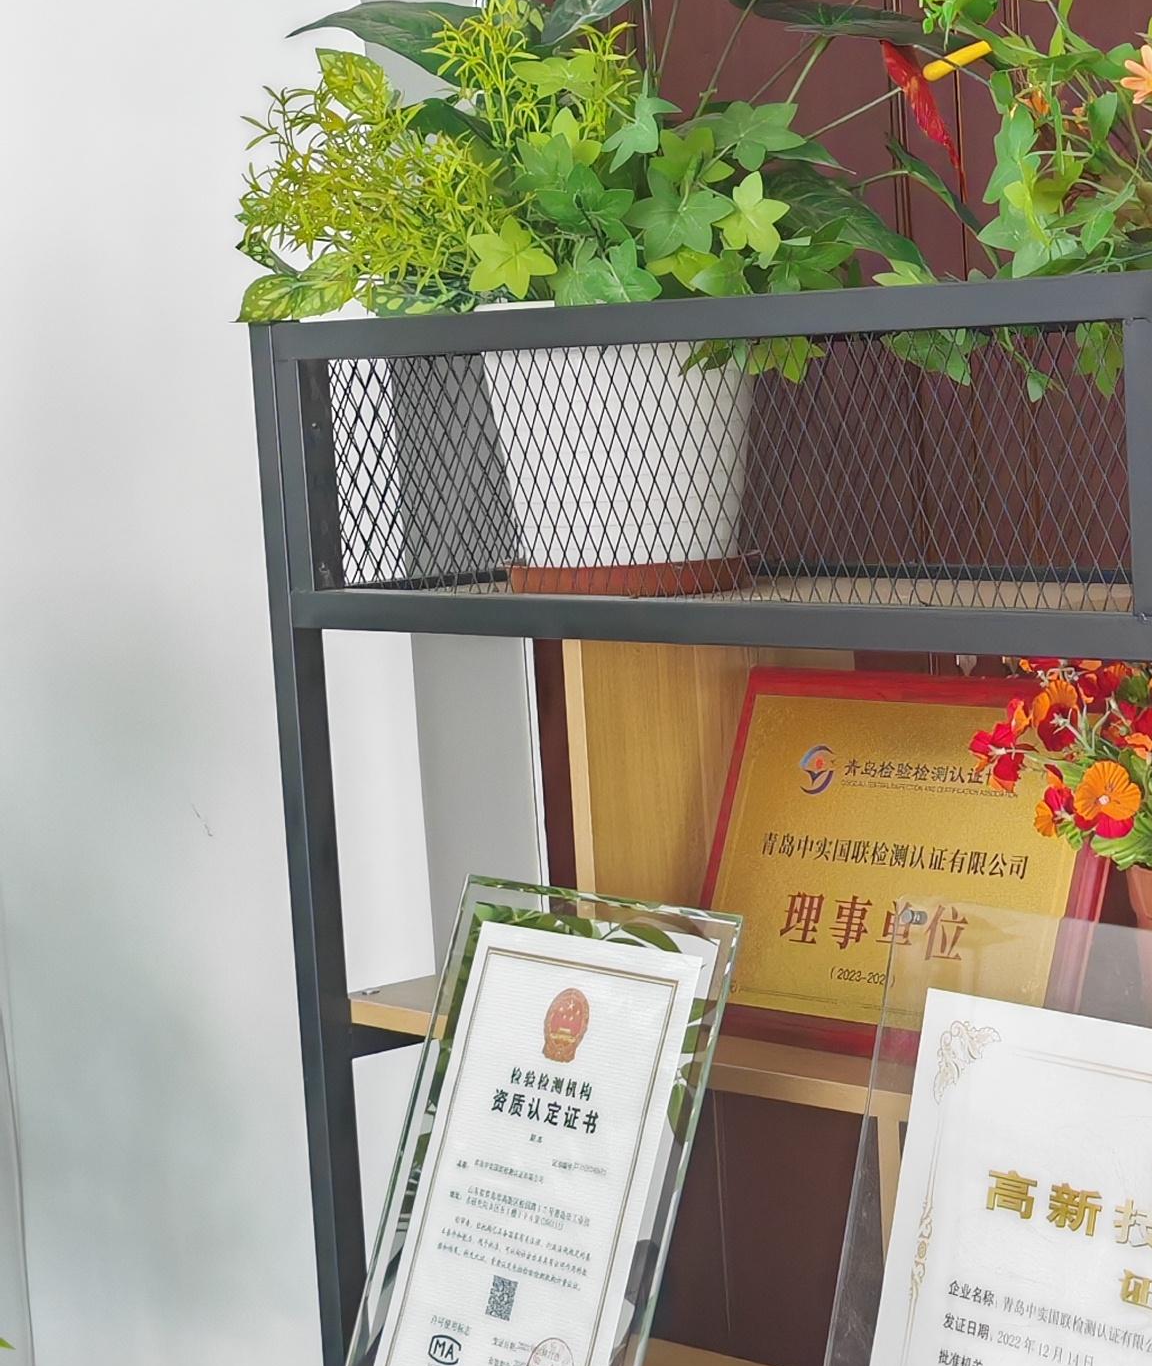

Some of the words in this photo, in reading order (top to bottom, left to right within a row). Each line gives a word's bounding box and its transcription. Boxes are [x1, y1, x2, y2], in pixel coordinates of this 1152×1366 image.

[761, 832, 1030, 880] 青岛中实国联检测认证有限公司
[780, 891, 968, 961] 理事单位
[830, 967, 896, 988] (2023-202)
[510, 1067, 593, 1102] 检验检测机构
[491, 1088, 599, 1134] 资质认定证书
